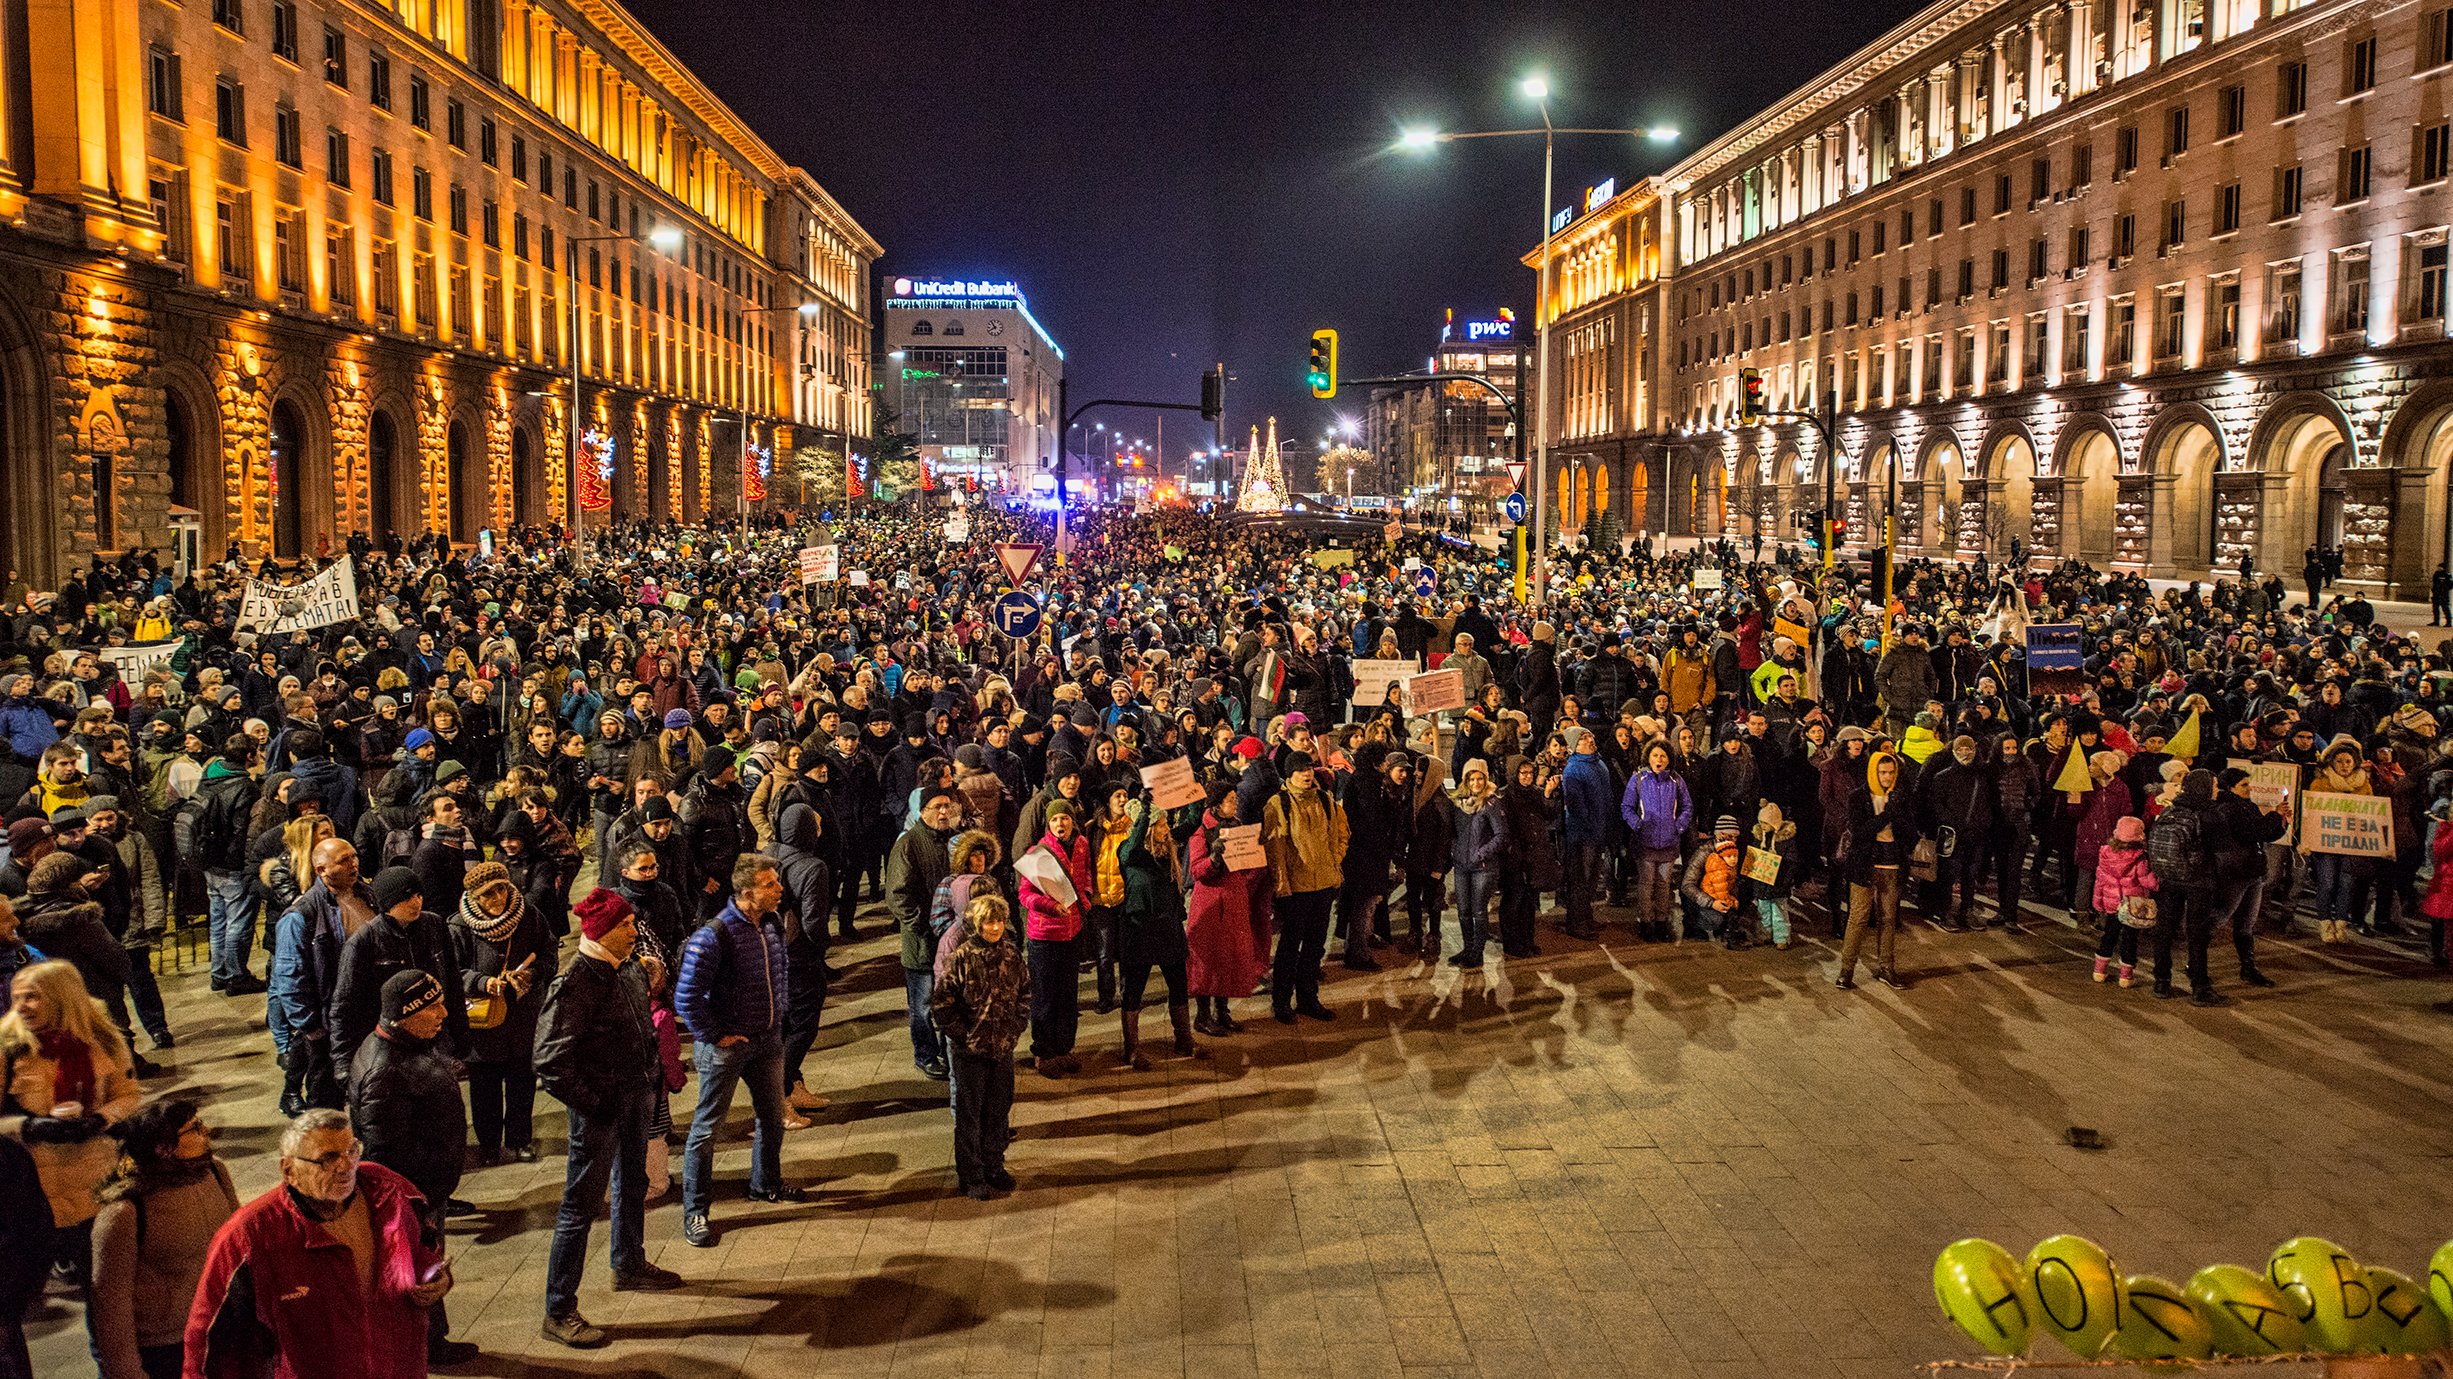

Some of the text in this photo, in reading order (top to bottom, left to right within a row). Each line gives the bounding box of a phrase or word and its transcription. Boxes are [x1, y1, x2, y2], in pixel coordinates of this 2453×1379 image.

[914, 280, 1015, 296] UniCredit Bulbank
[1469, 321, 1511, 340] pwc
[2321, 815, 2379, 833] НЕ Е ЗА
[402, 998, 424, 1014] AIR
